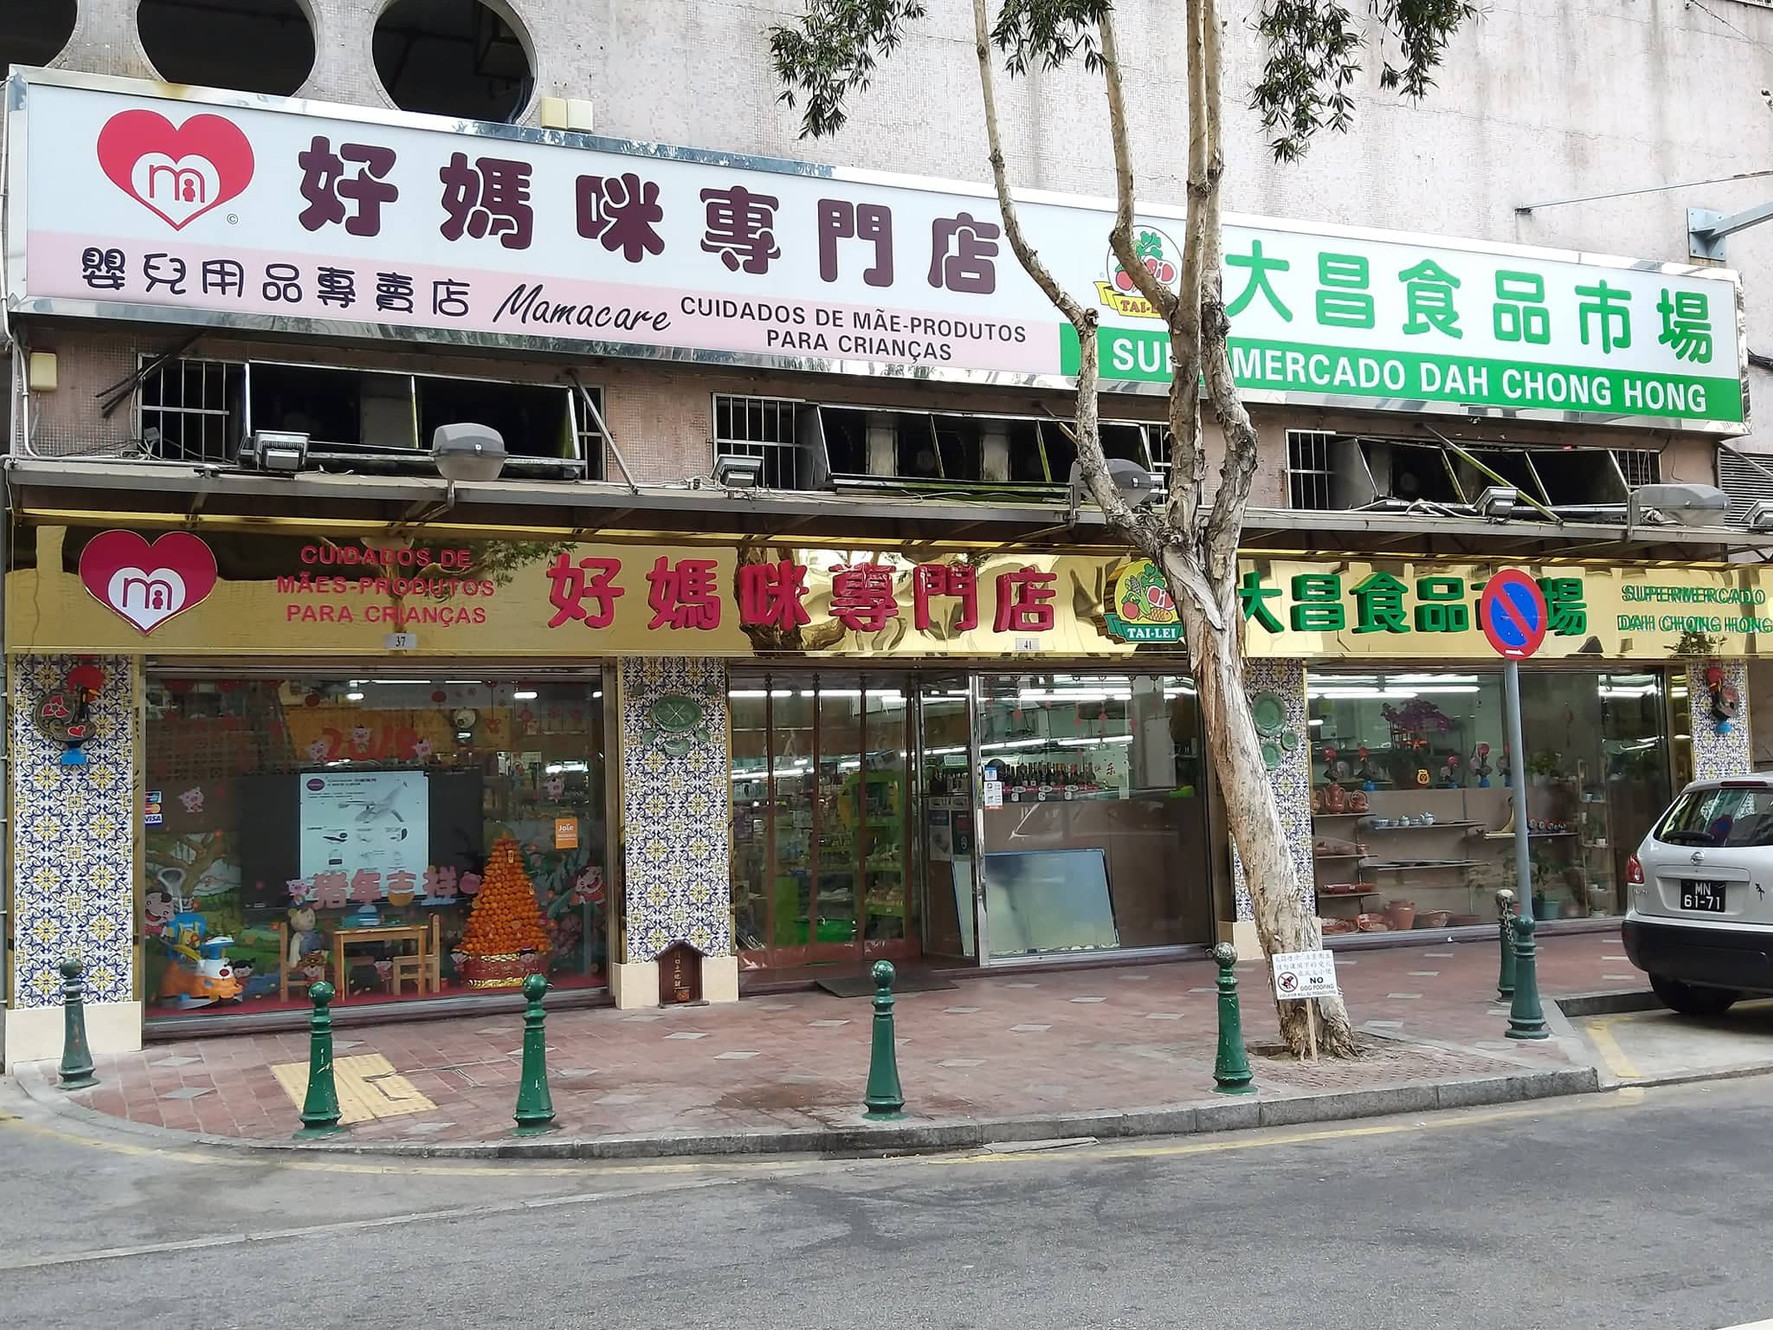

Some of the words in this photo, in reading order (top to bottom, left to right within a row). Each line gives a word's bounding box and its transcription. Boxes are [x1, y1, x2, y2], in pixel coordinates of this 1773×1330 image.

[298, 135, 1000, 295] 好媽咪專門店
[81, 247, 471, 317] 嬰兒用品專賣店
[492, 283, 672, 331] Mamacare
[1225, 239, 1714, 364] 大昌食品市場
[681, 296, 806, 325] CUIDADOS
[815, 309, 844, 328] DE
[853, 308, 1027, 343] MÃE-PRODUTOS
[766, 329, 829, 351] PARA
[838, 335, 952, 365] CRIANÇAS
[1111, 337, 1405, 390] SUMERCADO
[1419, 362, 1489, 397] DAH
[1502, 368, 1612, 406] CHONG
[1624, 378, 1708, 413] HONG
[300, 545, 431, 567] CUIDADOS
[440, 549, 473, 568] DE
[276, 570, 495, 597] MÃES-PRODUTOS
[546, 553, 1058, 633] 好媽咪專門店
[1621, 584, 1766, 605] SUPERMERCADO
[286, 604, 354, 623] PARA
[364, 605, 487, 628] CRIANÇAS
[1238, 571, 1588, 637] 大昌食品場
[1127, 627, 1177, 639] TAI-LEI
[1617, 614, 1655, 632] DAH
[1659, 614, 1722, 634] CHONG
[1724, 616, 1773, 635] HONG
[395, 635, 407, 648] 37
[1683, 894, 1721, 909] 61-71
[1694, 882, 1712, 896] MN
[1309, 976, 1324, 984] NO
